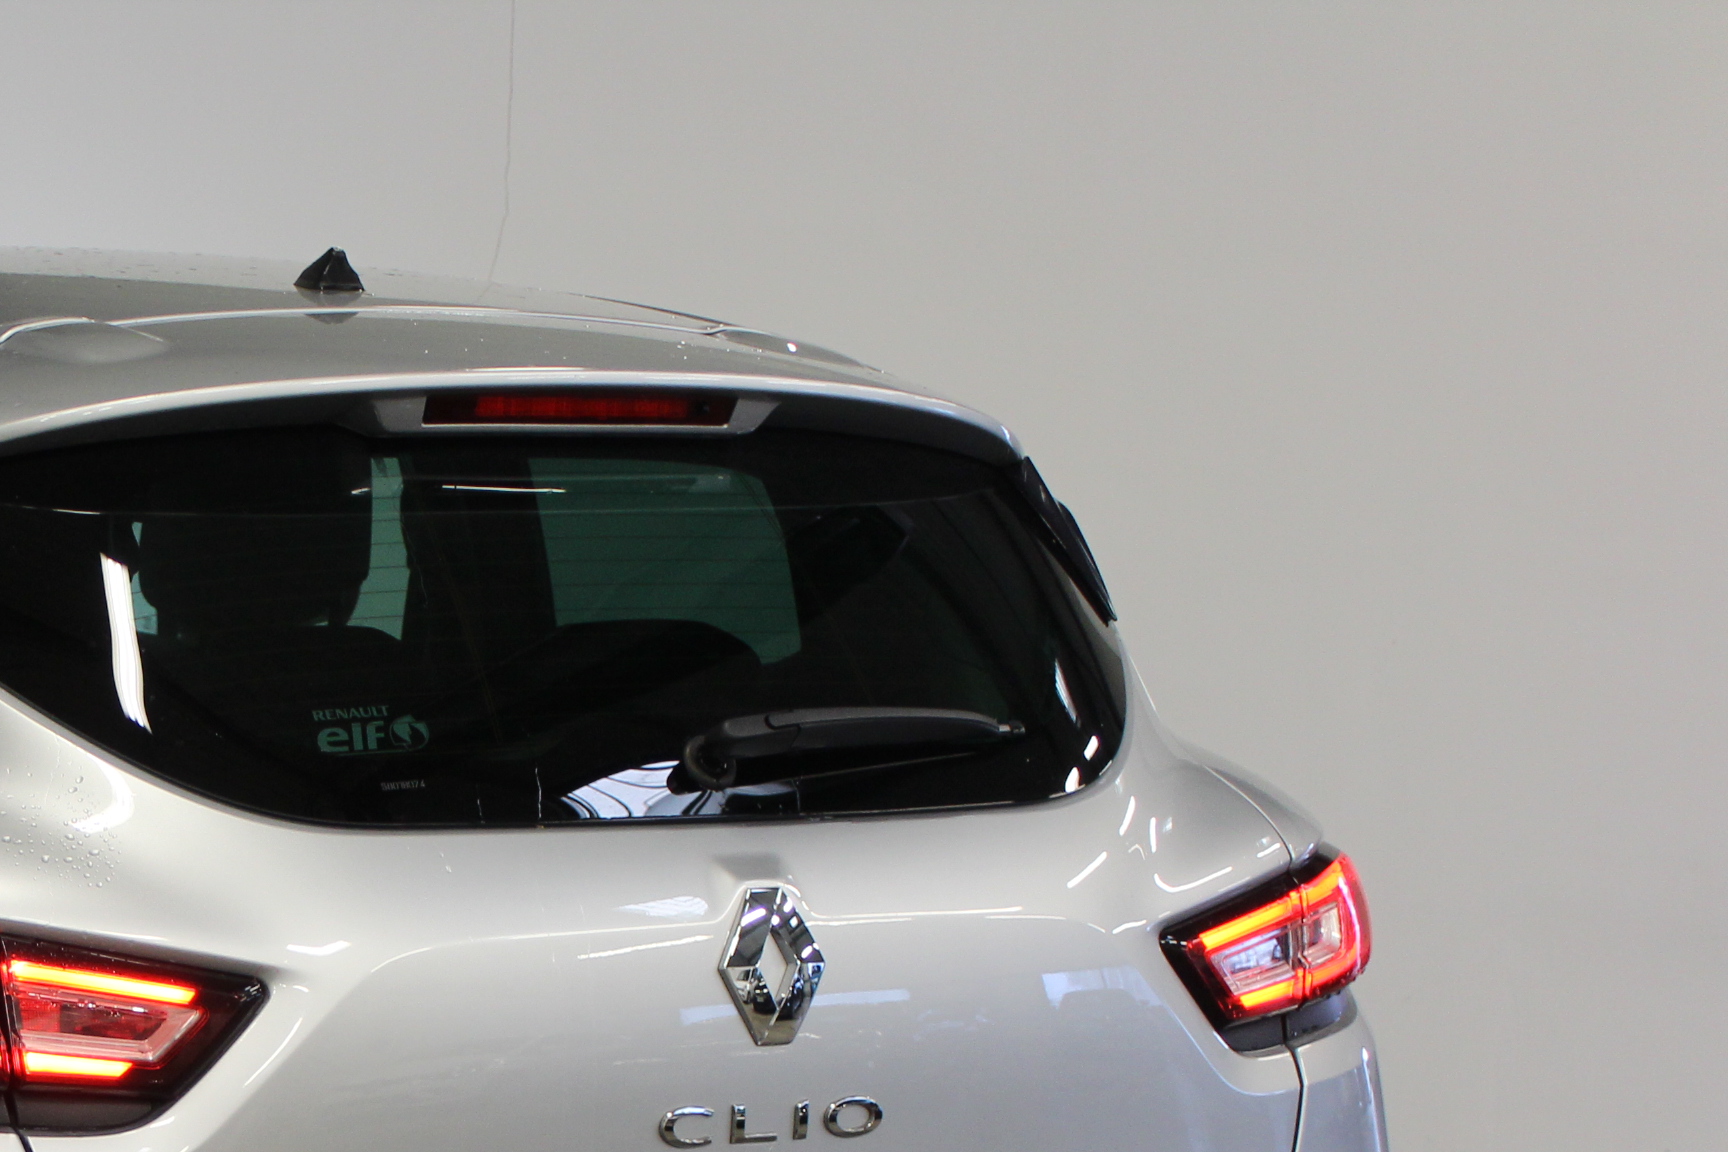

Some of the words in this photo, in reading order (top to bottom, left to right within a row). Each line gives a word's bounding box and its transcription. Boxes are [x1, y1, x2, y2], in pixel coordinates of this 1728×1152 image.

[312, 705, 389, 722] RENAULT
[317, 720, 385, 752] elf
[658, 1095, 884, 1149] CLIO
